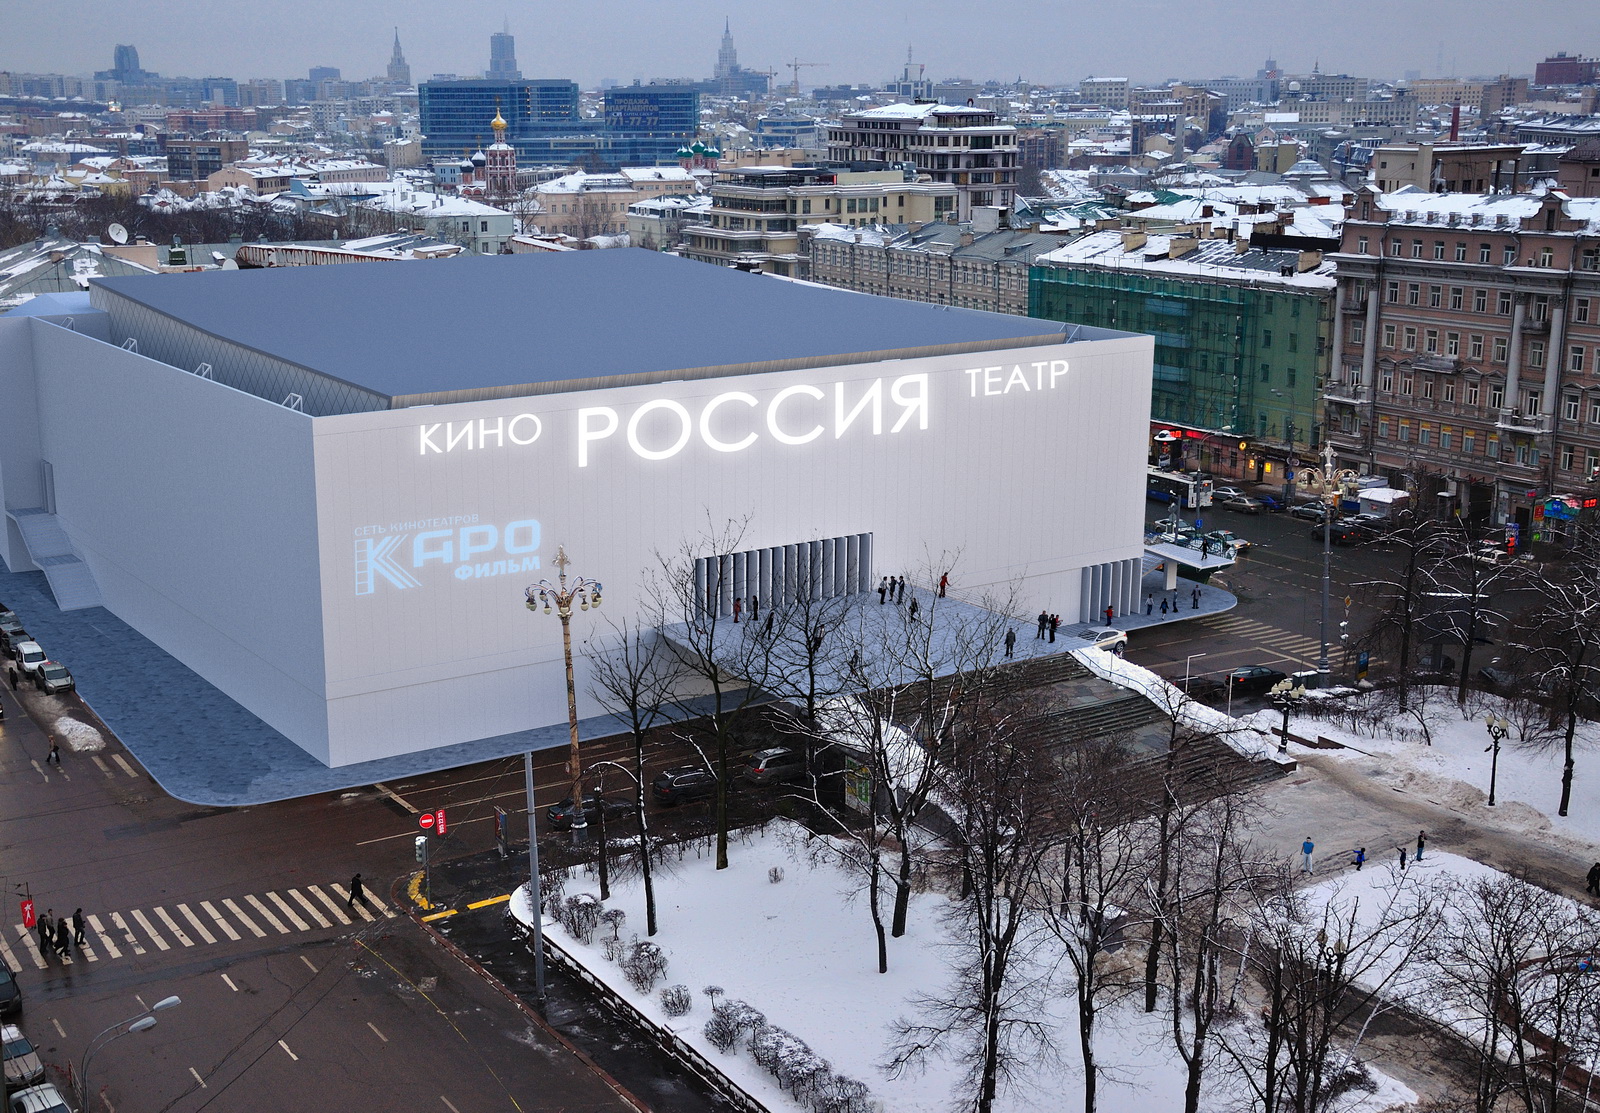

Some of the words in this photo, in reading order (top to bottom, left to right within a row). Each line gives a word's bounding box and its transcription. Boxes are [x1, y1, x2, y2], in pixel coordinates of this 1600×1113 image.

[605, 116, 659, 126] 771-77-77
[420, 413, 542, 455] КИНО
[578, 373, 929, 468] РОССИЯ
[965, 360, 1069, 398] ТЕАТР
[354, 525, 386, 537] СЕТЬ
[390, 513, 479, 532] КИНОТЕАТРОВ
[355, 519, 541, 596] КАРО
